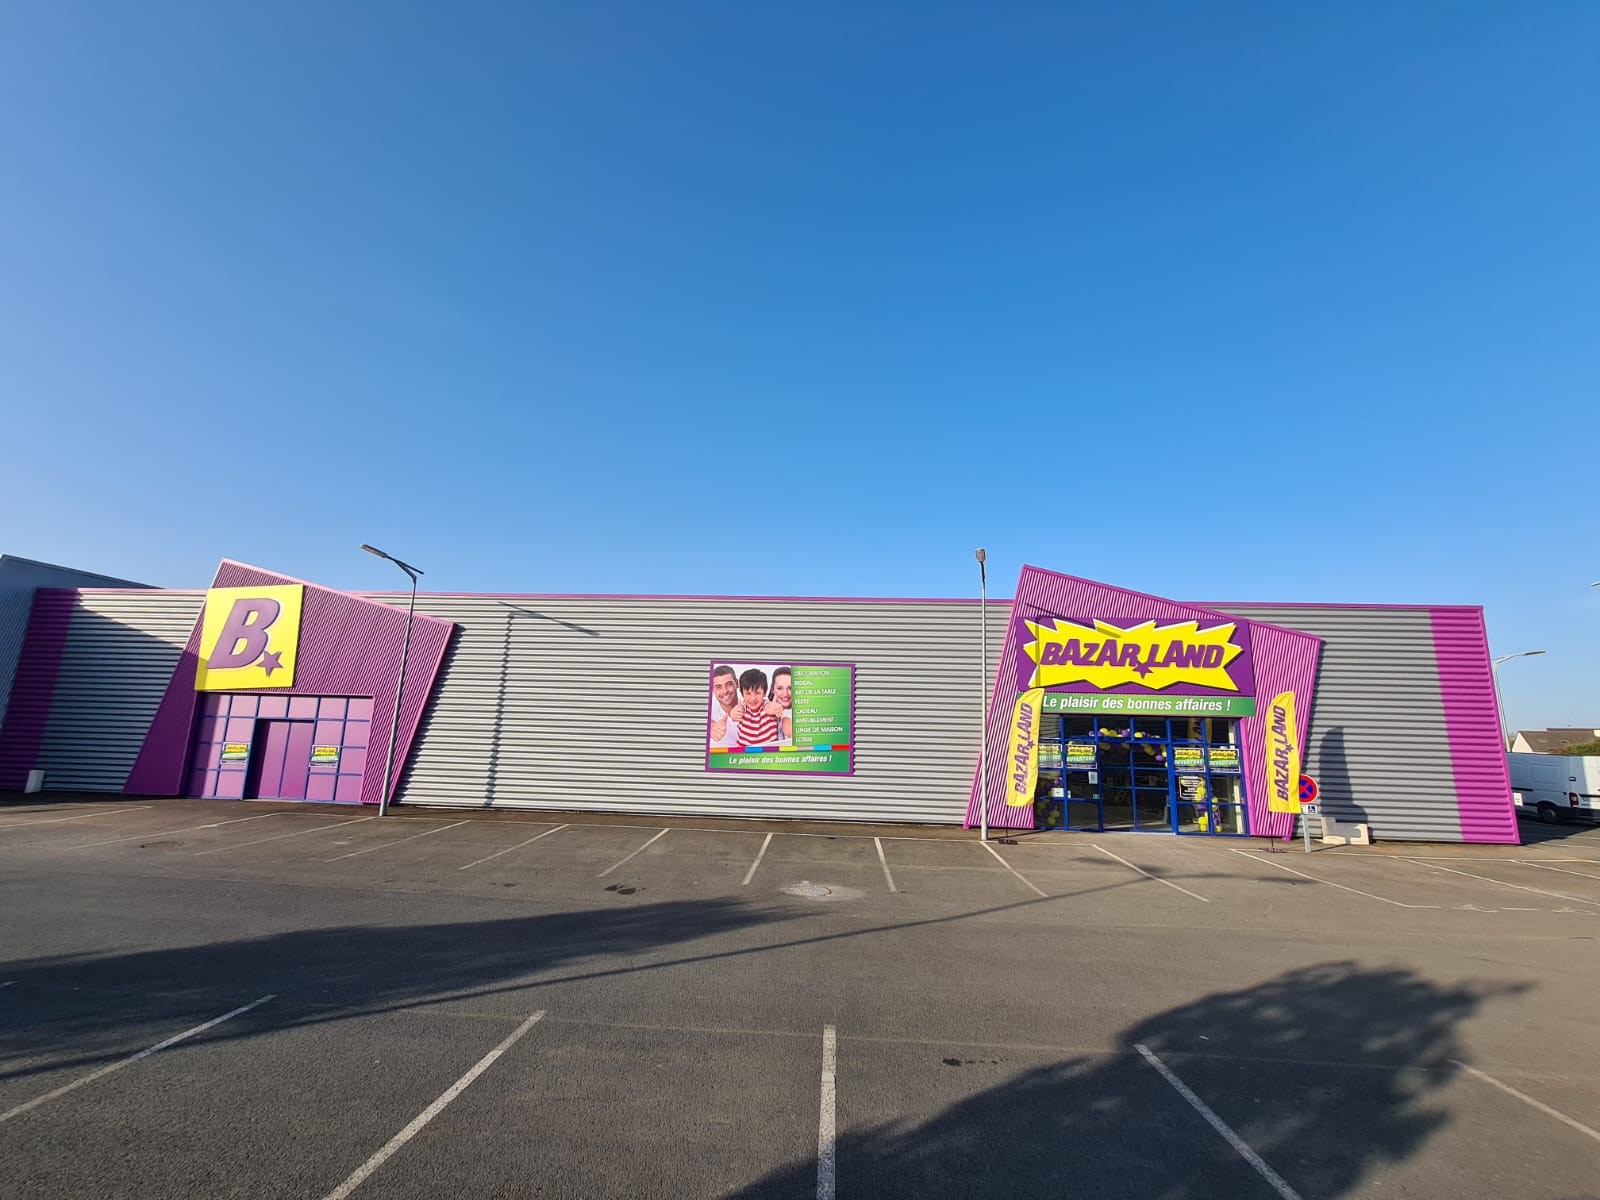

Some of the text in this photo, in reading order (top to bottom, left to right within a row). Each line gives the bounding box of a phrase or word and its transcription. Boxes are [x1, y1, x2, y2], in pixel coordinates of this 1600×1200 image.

[206, 598, 281, 670] B
[1043, 695, 1231, 711] Le plaisir des bonnes affaires !
[738, 757, 760, 765] plaisir
[762, 756, 774, 764] des
[801, 755, 828, 763] affaires
